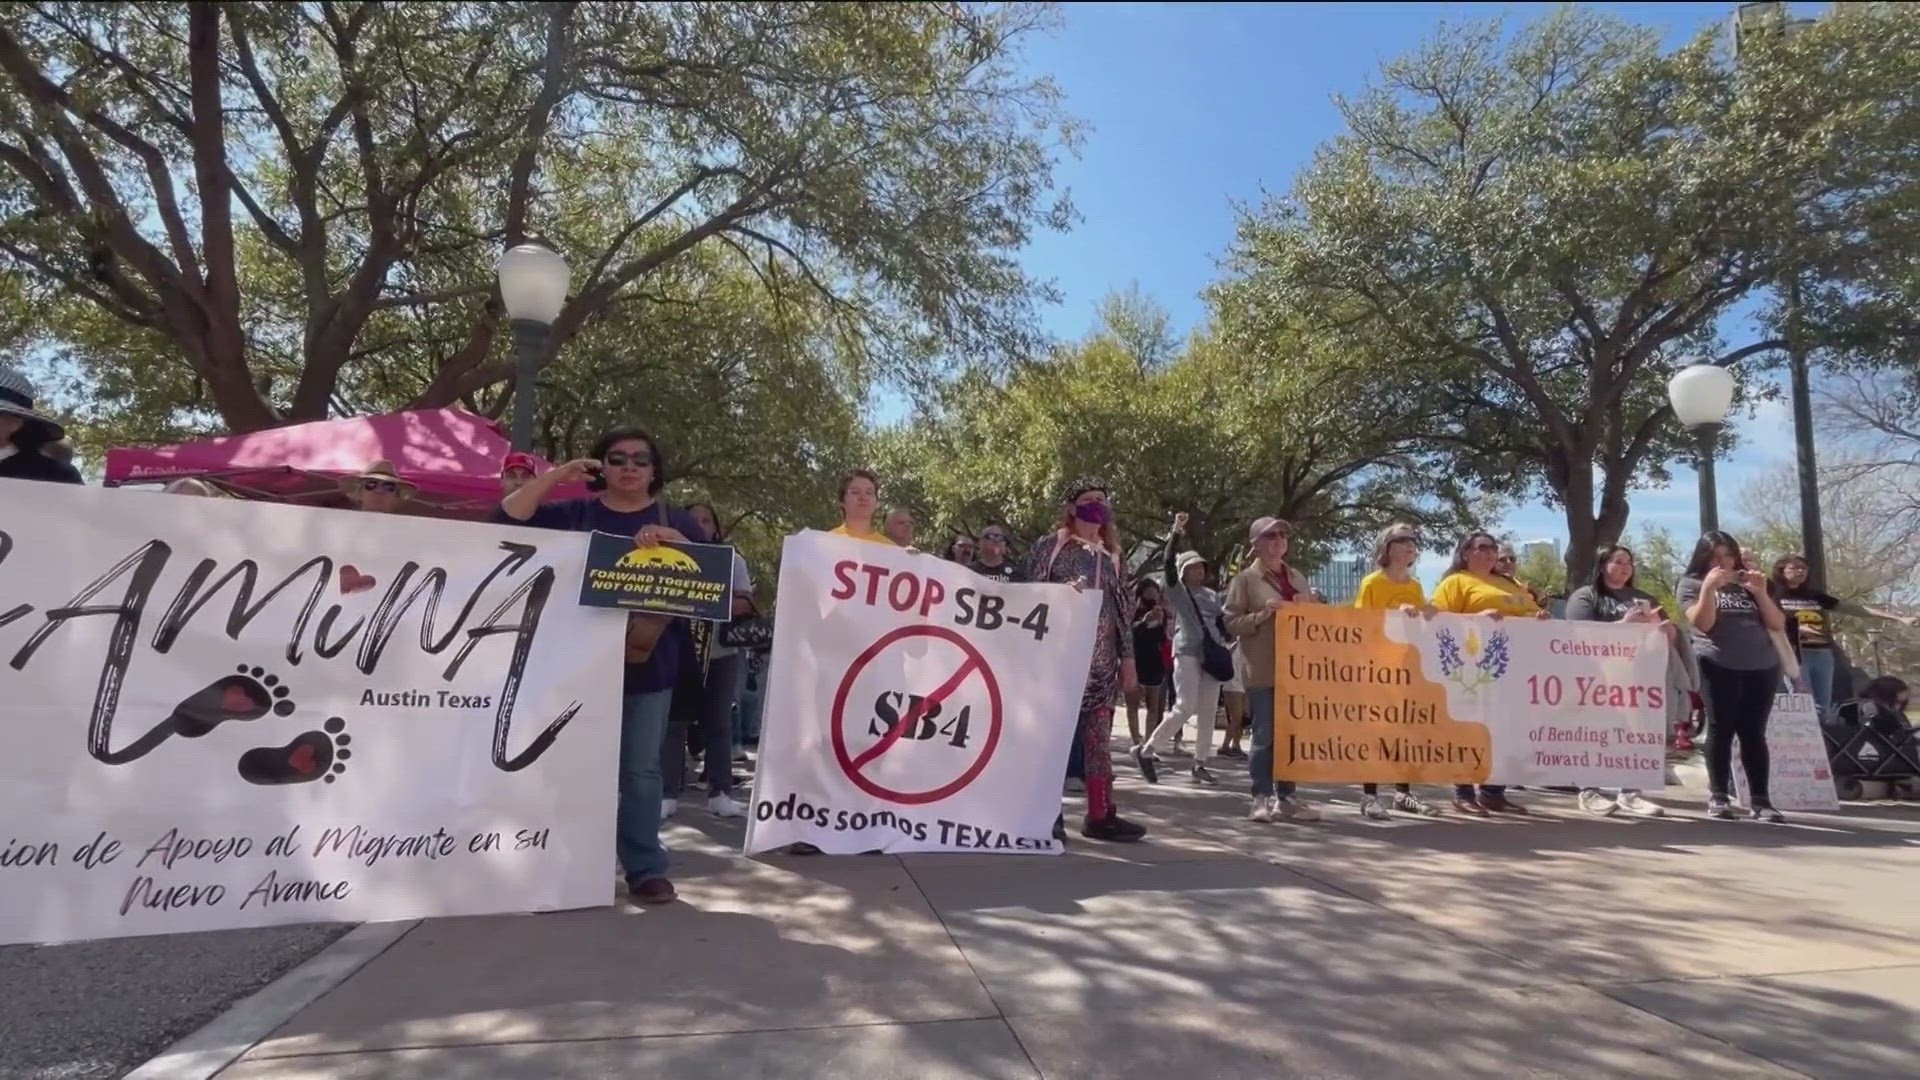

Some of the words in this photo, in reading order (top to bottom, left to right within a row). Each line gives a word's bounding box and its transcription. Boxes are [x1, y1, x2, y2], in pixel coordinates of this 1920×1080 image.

[589, 569, 655, 583] FORWARD
[658, 576, 726, 592] TOGETHER!
[591, 580, 623, 591] NOT
[624, 583, 653, 594] ONE
[654, 586, 686, 597] STEP
[687, 591, 721, 602] BACK
[831, 560, 945, 617] STOP
[954, 587, 1049, 641] SB-4
[1288, 615, 1363, 644] Texas
[1550, 639, 1637, 661] Celebrating
[1288, 654, 1411, 685] Unitarian
[360, 689, 430, 708] Austin
[437, 691, 492, 708] Texas
[1527, 674, 1562, 706] 10
[1575, 676, 1664, 709] Years
[868, 690, 971, 748] SB4
[1288, 694, 1437, 725] Universalist
[1287, 734, 1369, 766] Justice
[1378, 737, 1485, 770] Ministry
[1529, 726, 1544, 742] of
[1548, 726, 1609, 747] Bending
[1613, 727, 1664, 745] Texas
[1535, 751, 1590, 768] Toward
[1595, 753, 1660, 770] Justice
[756, 793, 829, 827] odos
[834, 810, 928, 841] somos
[0, 838, 58, 867] ion
[72, 831, 123, 869] de
[136, 827, 254, 869] Apoyo
[264, 824, 301, 857] al
[313, 825, 457, 867] Migrante
[468, 831, 502, 853] en
[515, 827, 550, 850] su
[119, 875, 226, 916] Nuevo
[240, 870, 350, 910] Avance
